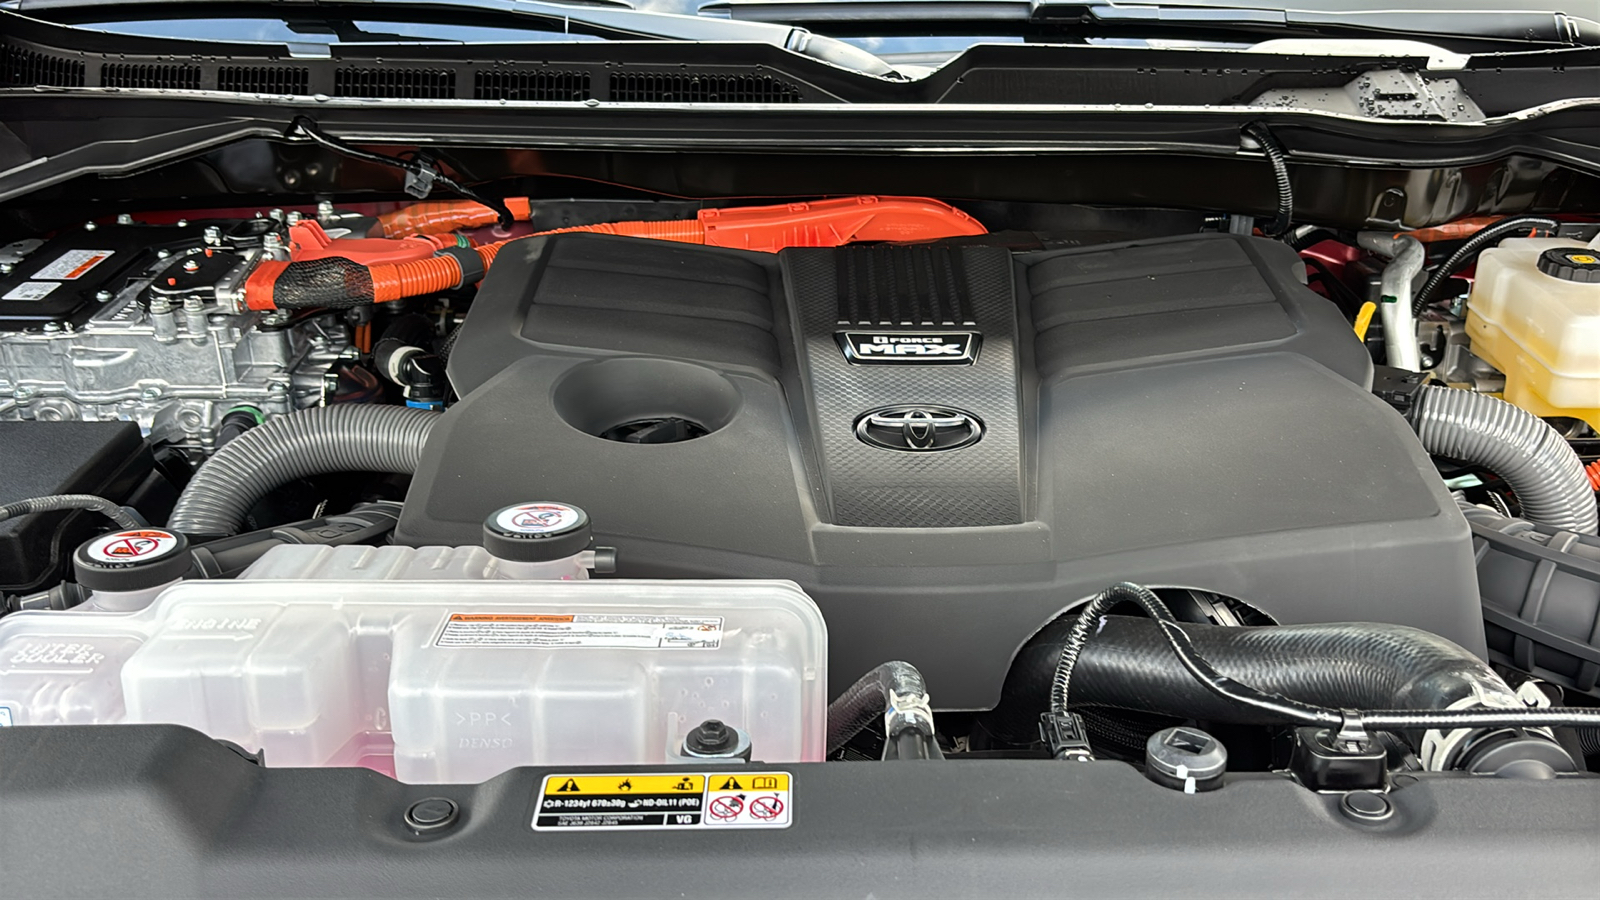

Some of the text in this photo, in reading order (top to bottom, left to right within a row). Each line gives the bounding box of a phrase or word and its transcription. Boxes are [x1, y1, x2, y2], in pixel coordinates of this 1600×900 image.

[859, 344, 962, 354] MAX
[169, 618, 261, 630] ENGINE
[459, 738, 513, 749] DENSO
[554, 799, 591, 808] R-1234yf
[676, 815, 692, 824] VG
